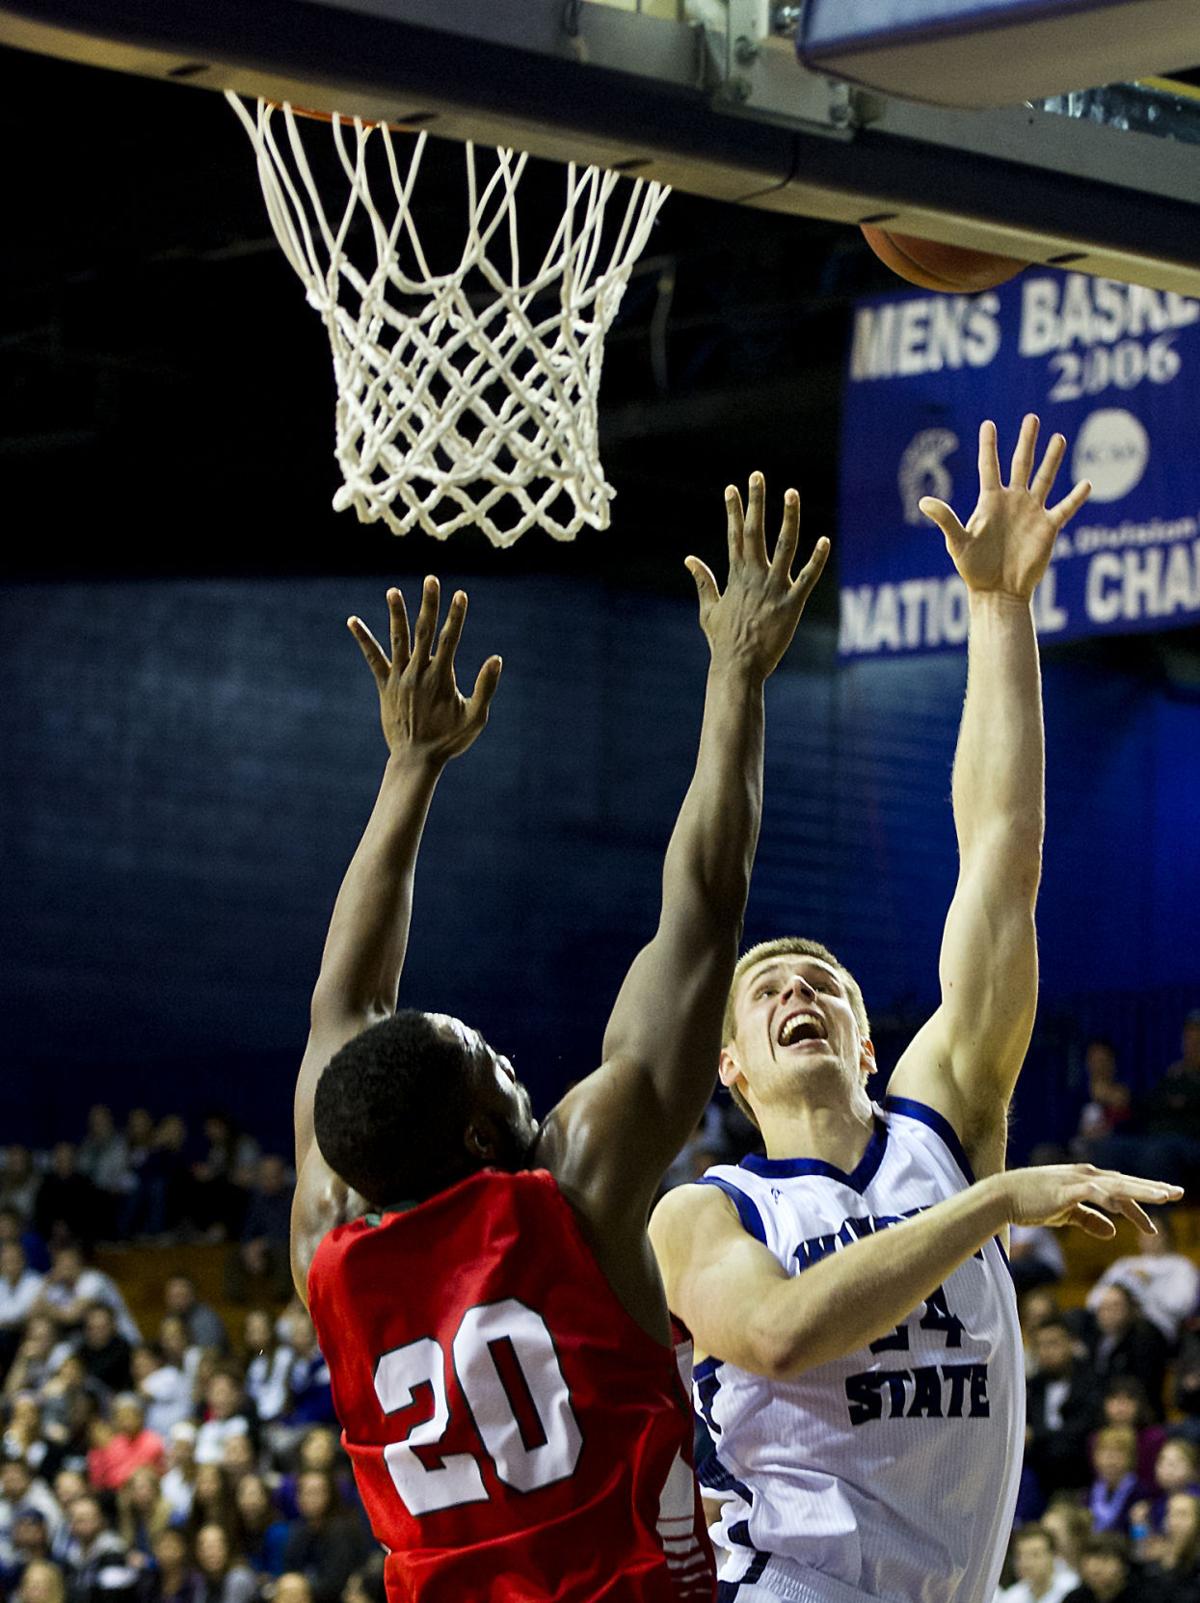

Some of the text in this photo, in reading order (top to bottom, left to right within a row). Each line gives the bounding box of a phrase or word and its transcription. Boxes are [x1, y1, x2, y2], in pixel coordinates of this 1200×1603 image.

[1048, 334, 1182, 403] 2006
[839, 536, 1200, 654] NATIOL CHA
[373, 1298, 583, 1518] 20
[845, 1364, 990, 1426] STATE
